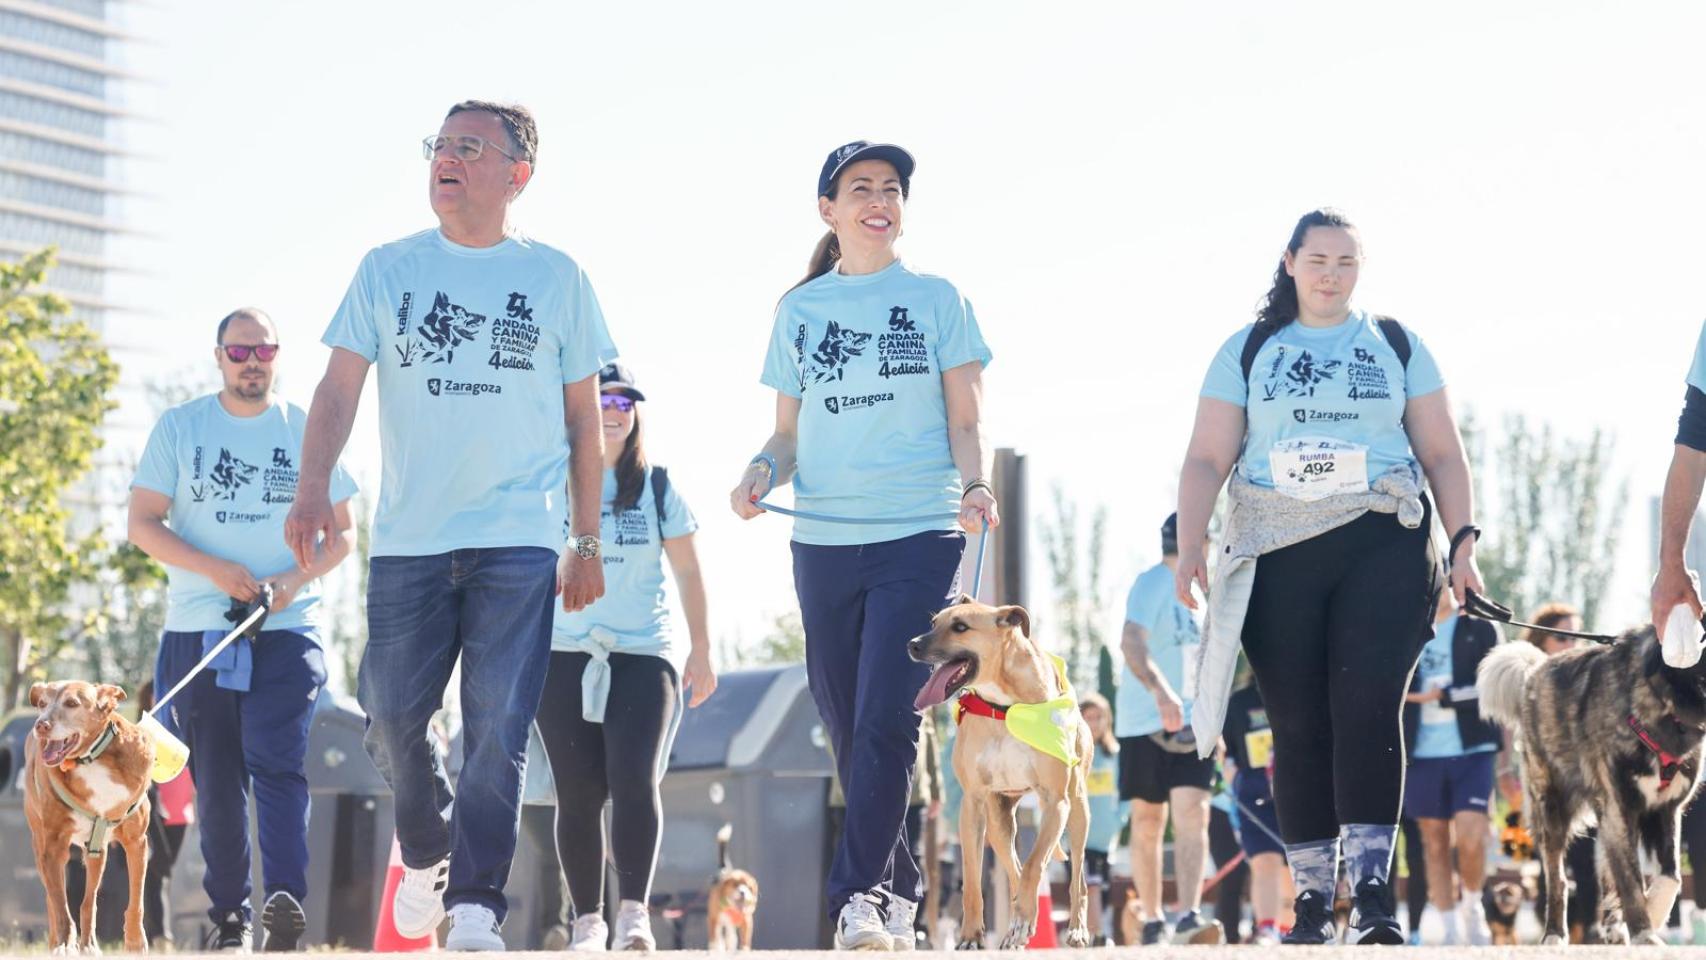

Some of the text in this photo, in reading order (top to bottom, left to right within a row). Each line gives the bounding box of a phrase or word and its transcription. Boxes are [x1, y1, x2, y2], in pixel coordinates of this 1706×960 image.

[492, 318, 540, 336] ANDADA
[491, 327, 538, 345] CANINA
[878, 332, 925, 342] ANDADA
[878, 340, 926, 350] CANINA
[886, 348, 928, 356] FAMILIAR
[1347, 368, 1386, 379] CANINA
[444, 380, 502, 396] Zaragoza
[841, 392, 894, 407] Zaragoza
[1309, 409, 1359, 422] Zaragoza
[1299, 453, 1336, 462] RUMBA
[1303, 461, 1335, 476] 492
